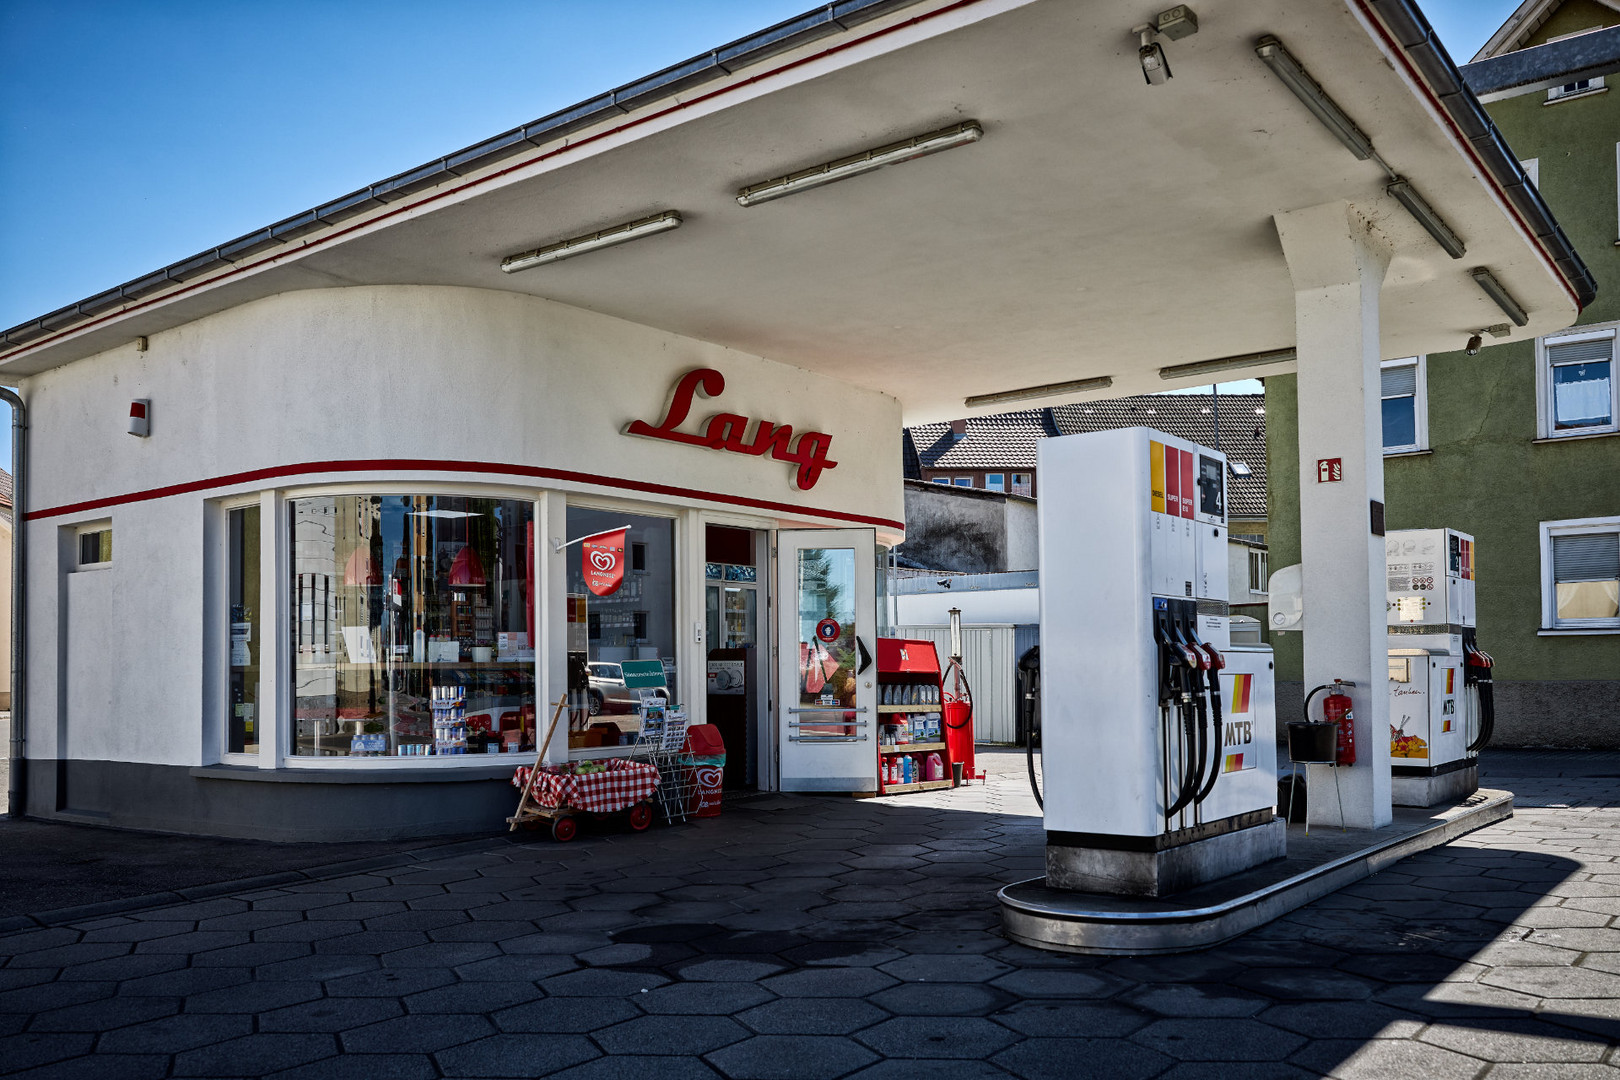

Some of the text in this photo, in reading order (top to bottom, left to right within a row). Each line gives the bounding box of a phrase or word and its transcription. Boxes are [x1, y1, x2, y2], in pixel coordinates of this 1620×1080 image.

[623, 368, 838, 491] Lang
[1152, 489, 1164, 498] DIESEL
[1167, 493, 1179, 502] SUPER
[1182, 497, 1193, 505] SUPER
[1215, 491, 1222, 509] 4
[590, 570, 614, 578] LANGNESE
[1443, 699, 1455, 715] MTB
[1224, 721, 1252, 746] MTB
